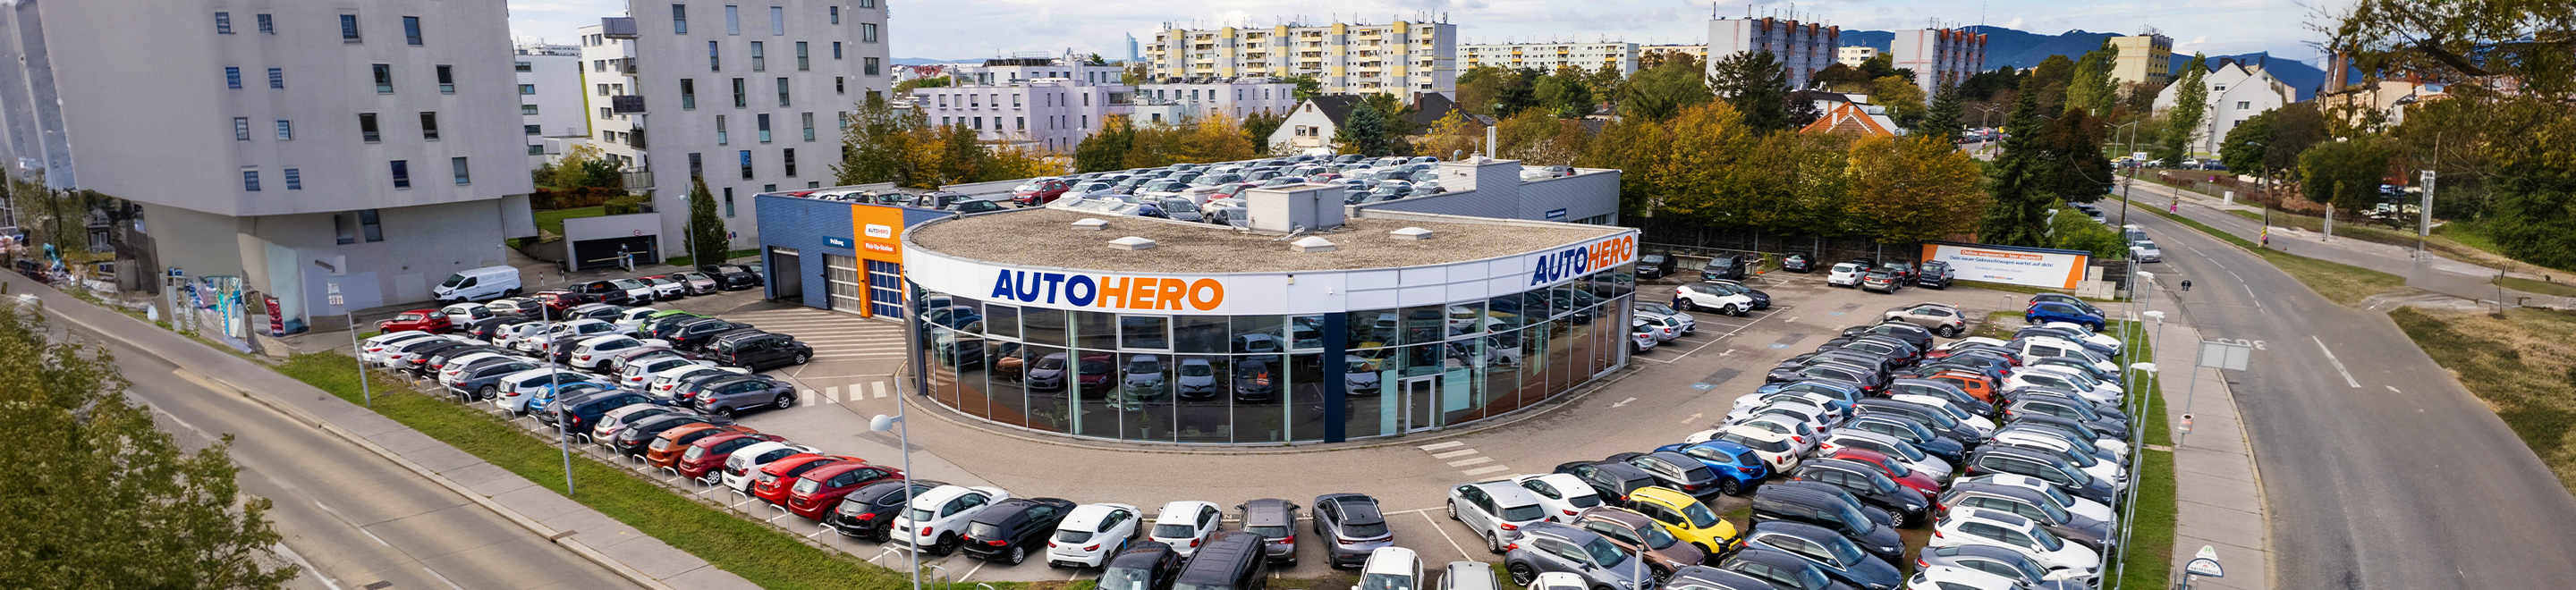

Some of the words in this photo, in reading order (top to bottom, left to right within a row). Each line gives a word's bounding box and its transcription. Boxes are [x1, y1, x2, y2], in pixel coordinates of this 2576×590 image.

[865, 242, 894, 252] Pick-Up-Station
[1530, 235, 1633, 286] AUTOHERO
[991, 268, 1224, 311] AUTOHERO
